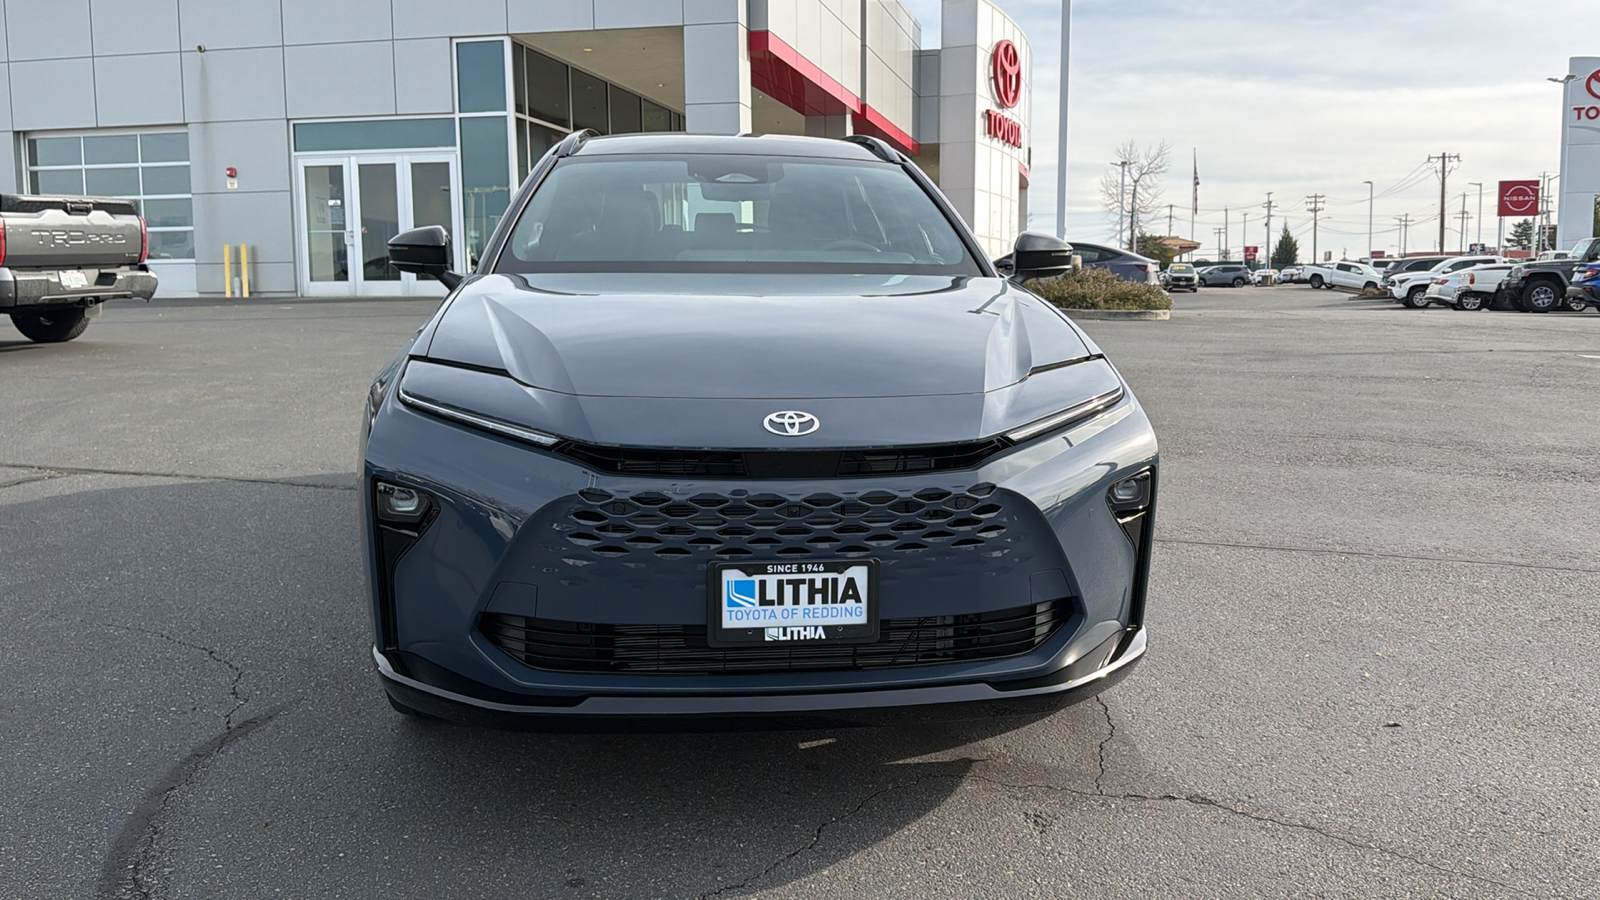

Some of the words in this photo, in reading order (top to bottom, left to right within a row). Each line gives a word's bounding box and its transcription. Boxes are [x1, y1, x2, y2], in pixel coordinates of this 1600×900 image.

[1573, 105, 1600, 120] TO
[985, 109, 1022, 149] TOYOTA
[31, 230, 85, 247] TRD
[767, 565, 798, 573] SINCE
[801, 564, 825, 572] 1946
[758, 577, 862, 606] LITHIA
[727, 608, 777, 621] TOYOTA
[781, 608, 799, 619] OF
[802, 606, 863, 618] REDDING
[778, 626, 826, 640] LITHIA
